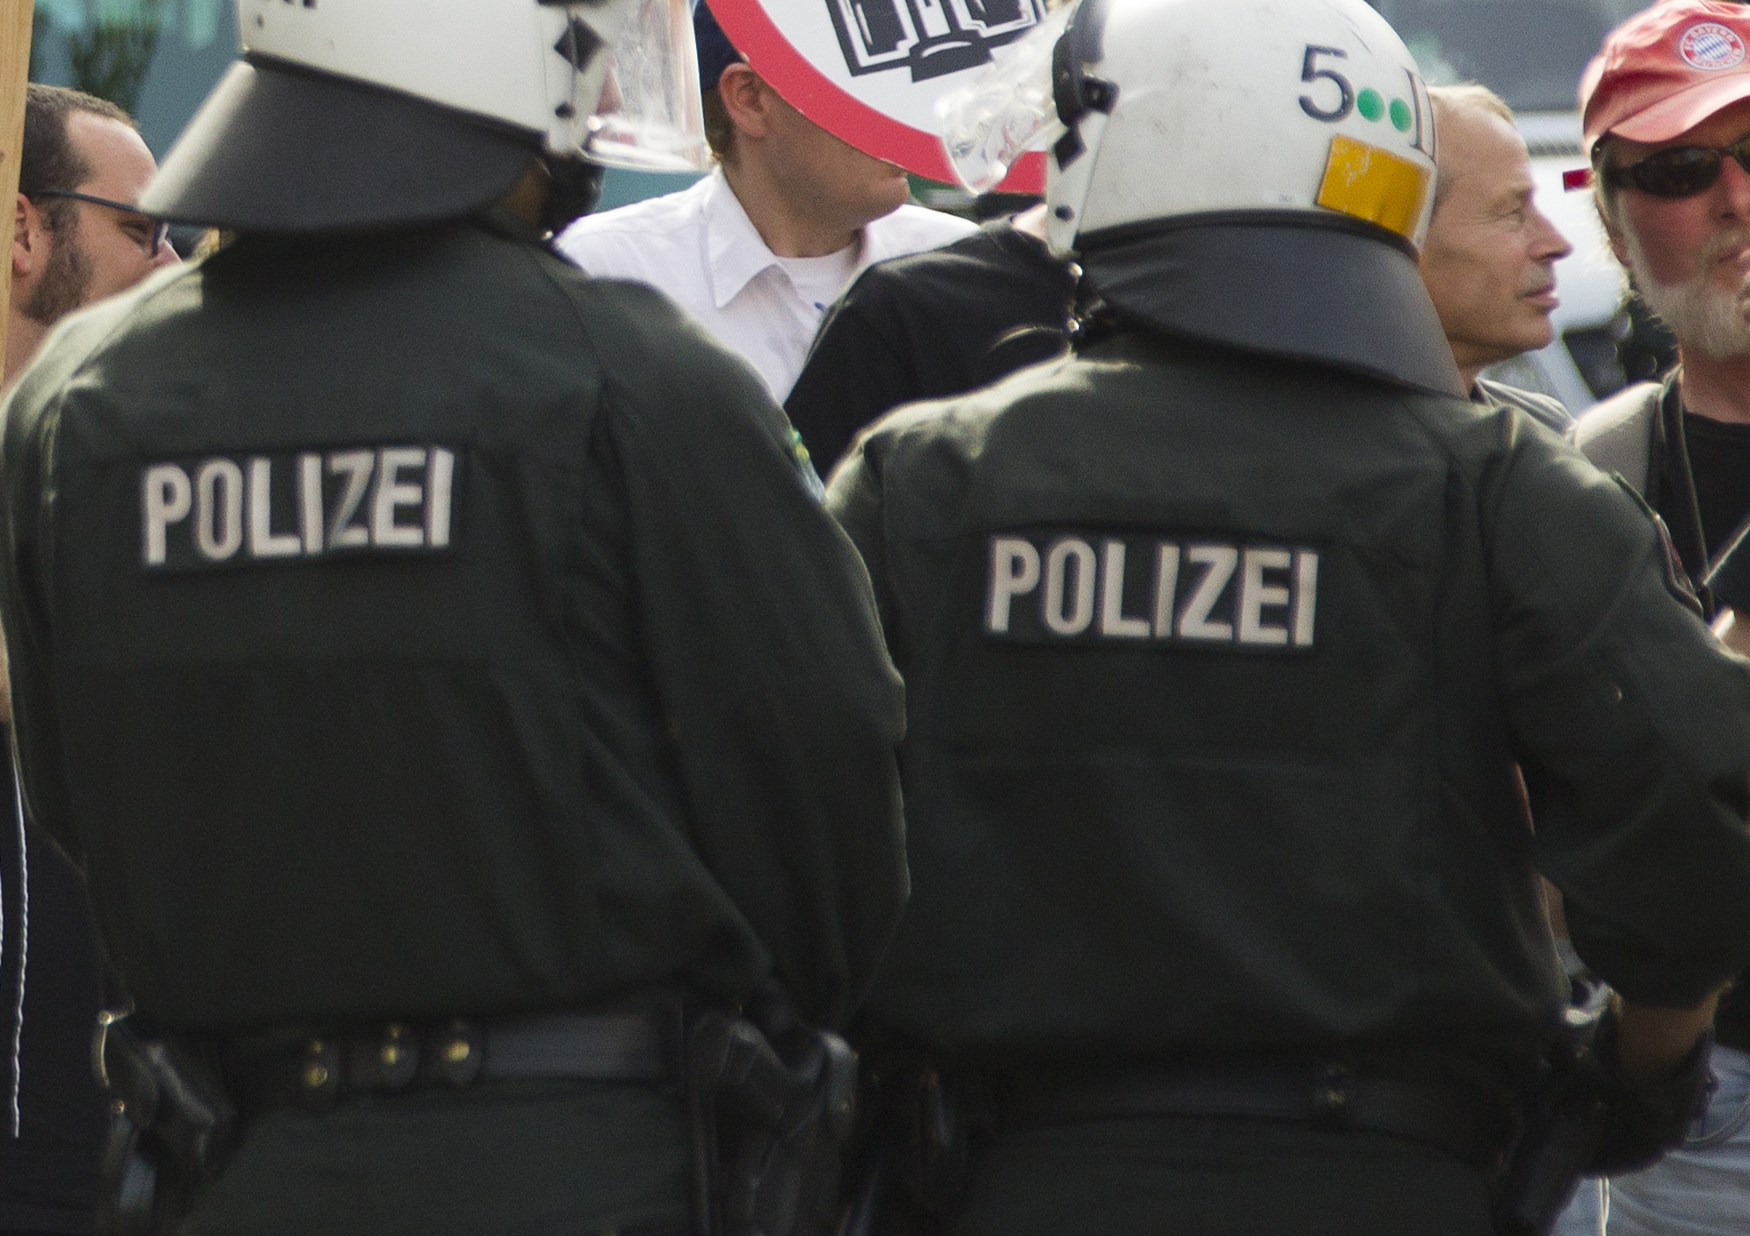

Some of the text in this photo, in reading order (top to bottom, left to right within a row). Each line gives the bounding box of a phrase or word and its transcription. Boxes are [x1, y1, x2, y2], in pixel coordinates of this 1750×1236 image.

[1298, 44, 1355, 124] 5
[143, 445, 455, 565] POLIZEI
[989, 536, 1319, 648] POLIZEI
